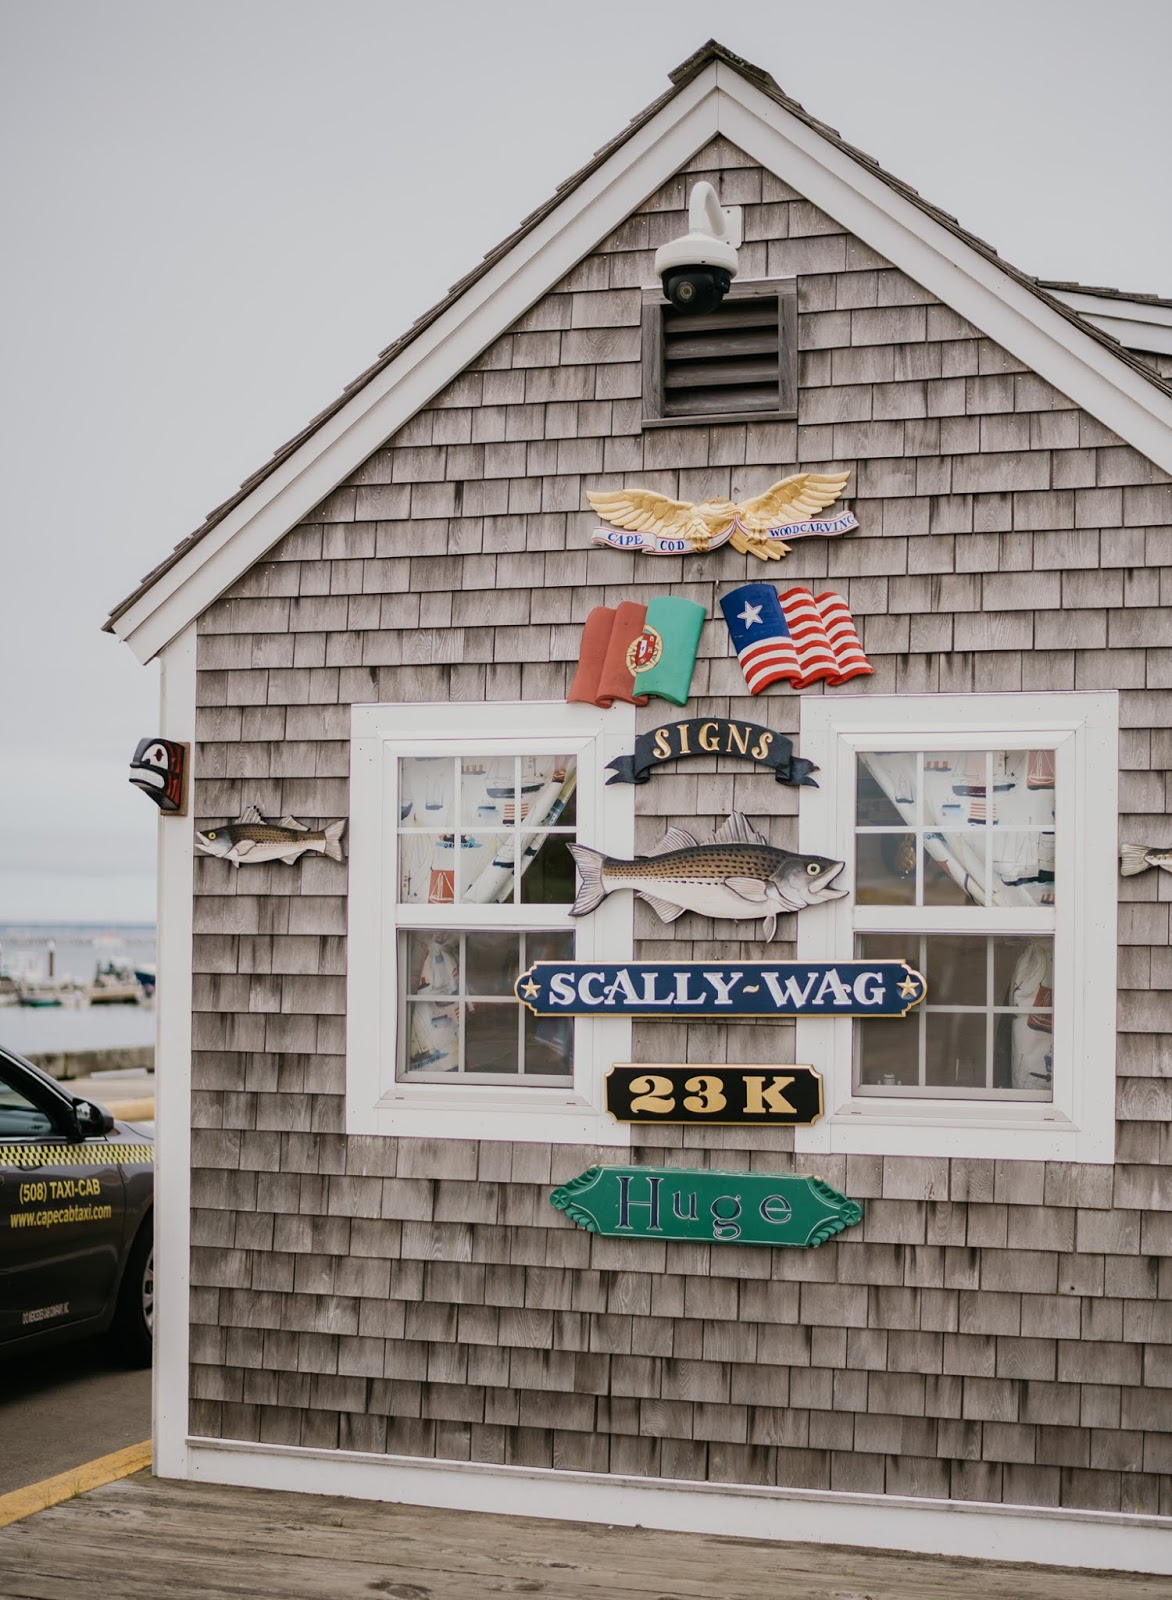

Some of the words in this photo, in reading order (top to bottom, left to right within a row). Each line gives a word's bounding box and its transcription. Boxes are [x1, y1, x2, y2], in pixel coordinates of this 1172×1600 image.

[607, 532, 644, 546] CAPE
[660, 540, 685, 551] COD
[769, 514, 855, 537] WOODCARVING
[652, 722, 773, 760] SIGNS
[628, 1075, 727, 1114] 23
[742, 1076, 797, 1114] K
[19, 1181, 47, 1205] (508)
[49, 1178, 101, 1199] TAXI-CAB
[614, 1176, 792, 1241] Huge
[10, 1203, 112, 1228] www.capecabtaxi.com
